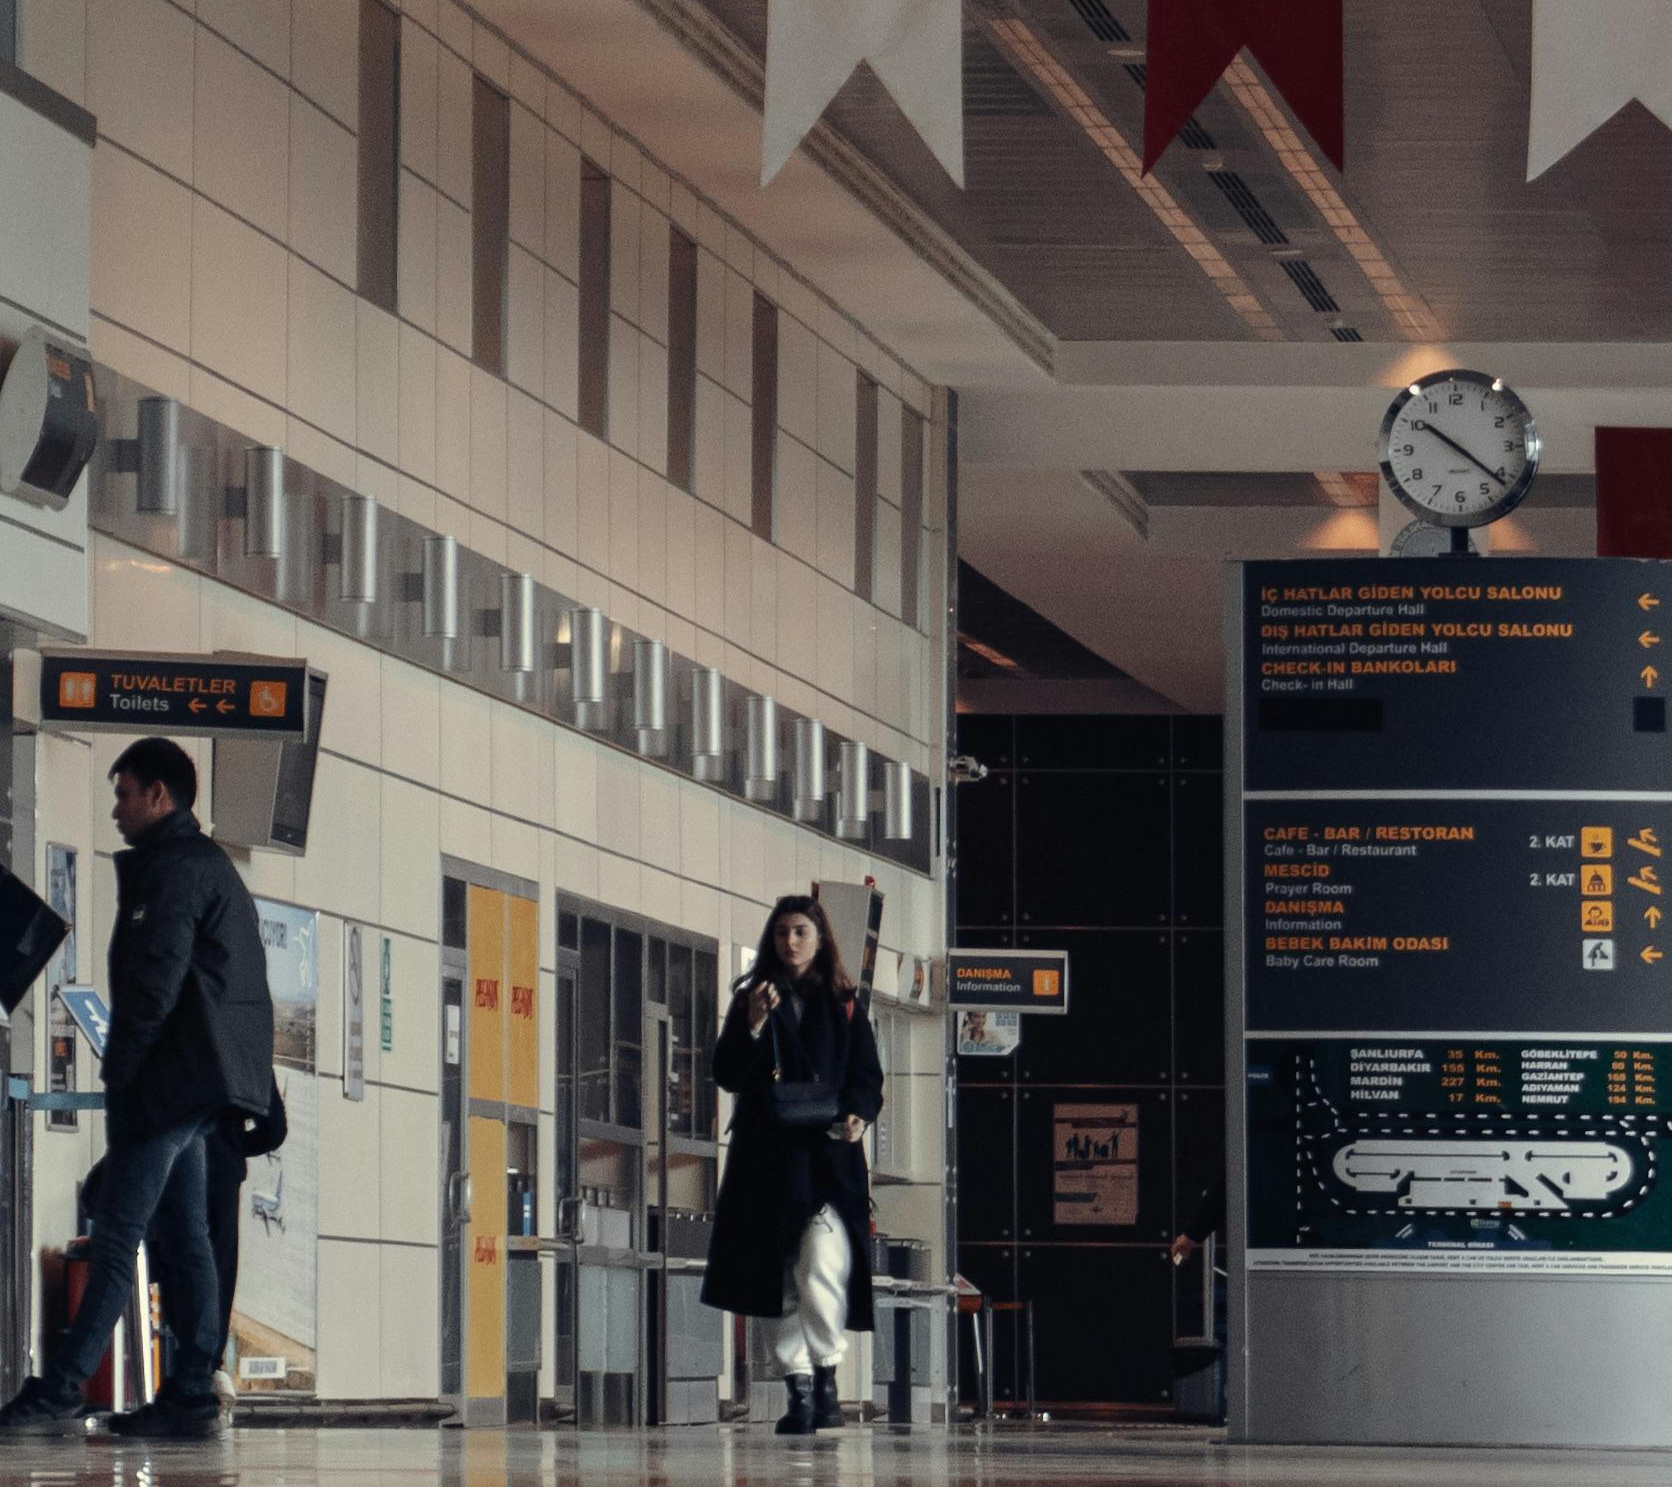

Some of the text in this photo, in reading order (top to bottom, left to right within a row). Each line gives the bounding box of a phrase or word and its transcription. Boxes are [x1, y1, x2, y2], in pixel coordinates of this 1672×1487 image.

[1448, 394, 1463, 406] 12
[1429, 402, 1438, 414] 11
[1410, 419, 1426, 431] 10
[1494, 416, 1505, 428] 2
[1402, 444, 1414, 456] 9
[1504, 440, 1514, 452] 3
[1412, 468, 1423, 480] 8
[1432, 484, 1442, 496] 7
[1479, 483, 1490, 495] 5
[1454, 491, 1466, 503] 6
[1284, 587, 1352, 600] HATLAR
[1358, 583, 1414, 600] GİDEN
[1419, 586, 1481, 600] YOLCU
[1487, 586, 1561, 600] SALONU
[1261, 603, 1424, 618] Domestic Departure Hall
[1261, 620, 1573, 640] DIŞ HATLAR GİDEN YOLCU SALONU
[1262, 641, 1447, 656] International Departure Hall
[1261, 660, 1456, 675] CHECK-IN BANKOLARI
[111, 674, 236, 694] TUVALETLER
[1261, 678, 1308, 691] Check-
[1327, 678, 1353, 690] Hall
[110, 693, 169, 711] Toilets
[1264, 827, 1308, 841] CAFE
[1324, 826, 1360, 840] BAR
[1375, 826, 1474, 841] RESTORAN
[1529, 835, 1574, 849] 2. KAT
[1264, 844, 1294, 856] Cafe
[1306, 844, 1329, 856] Bar
[1341, 844, 1417, 856] Restaurant
[1264, 860, 1330, 877] MESCİD
[1529, 873, 1575, 886] 2. KAT
[1265, 882, 1352, 897] Prayer Room
[1264, 901, 1344, 916] DANIŞMA
[1265, 919, 1342, 931] Information
[1265, 937, 1324, 951] BEBEK
[1392, 937, 1449, 951] ODASI
[1266, 955, 1379, 970] Baby Care Room
[955, 967, 1013, 981] DANIŞMA
[956, 980, 1021, 992] Information
[1521, 1061, 1568, 1070] HARRAN
[1349, 1075, 1403, 1086] MARDİN
[1441, 1077, 1464, 1086] 227
[1349, 1089, 1400, 1100] HİLVAN
[1521, 1095, 1569, 1104] NEMRUT
